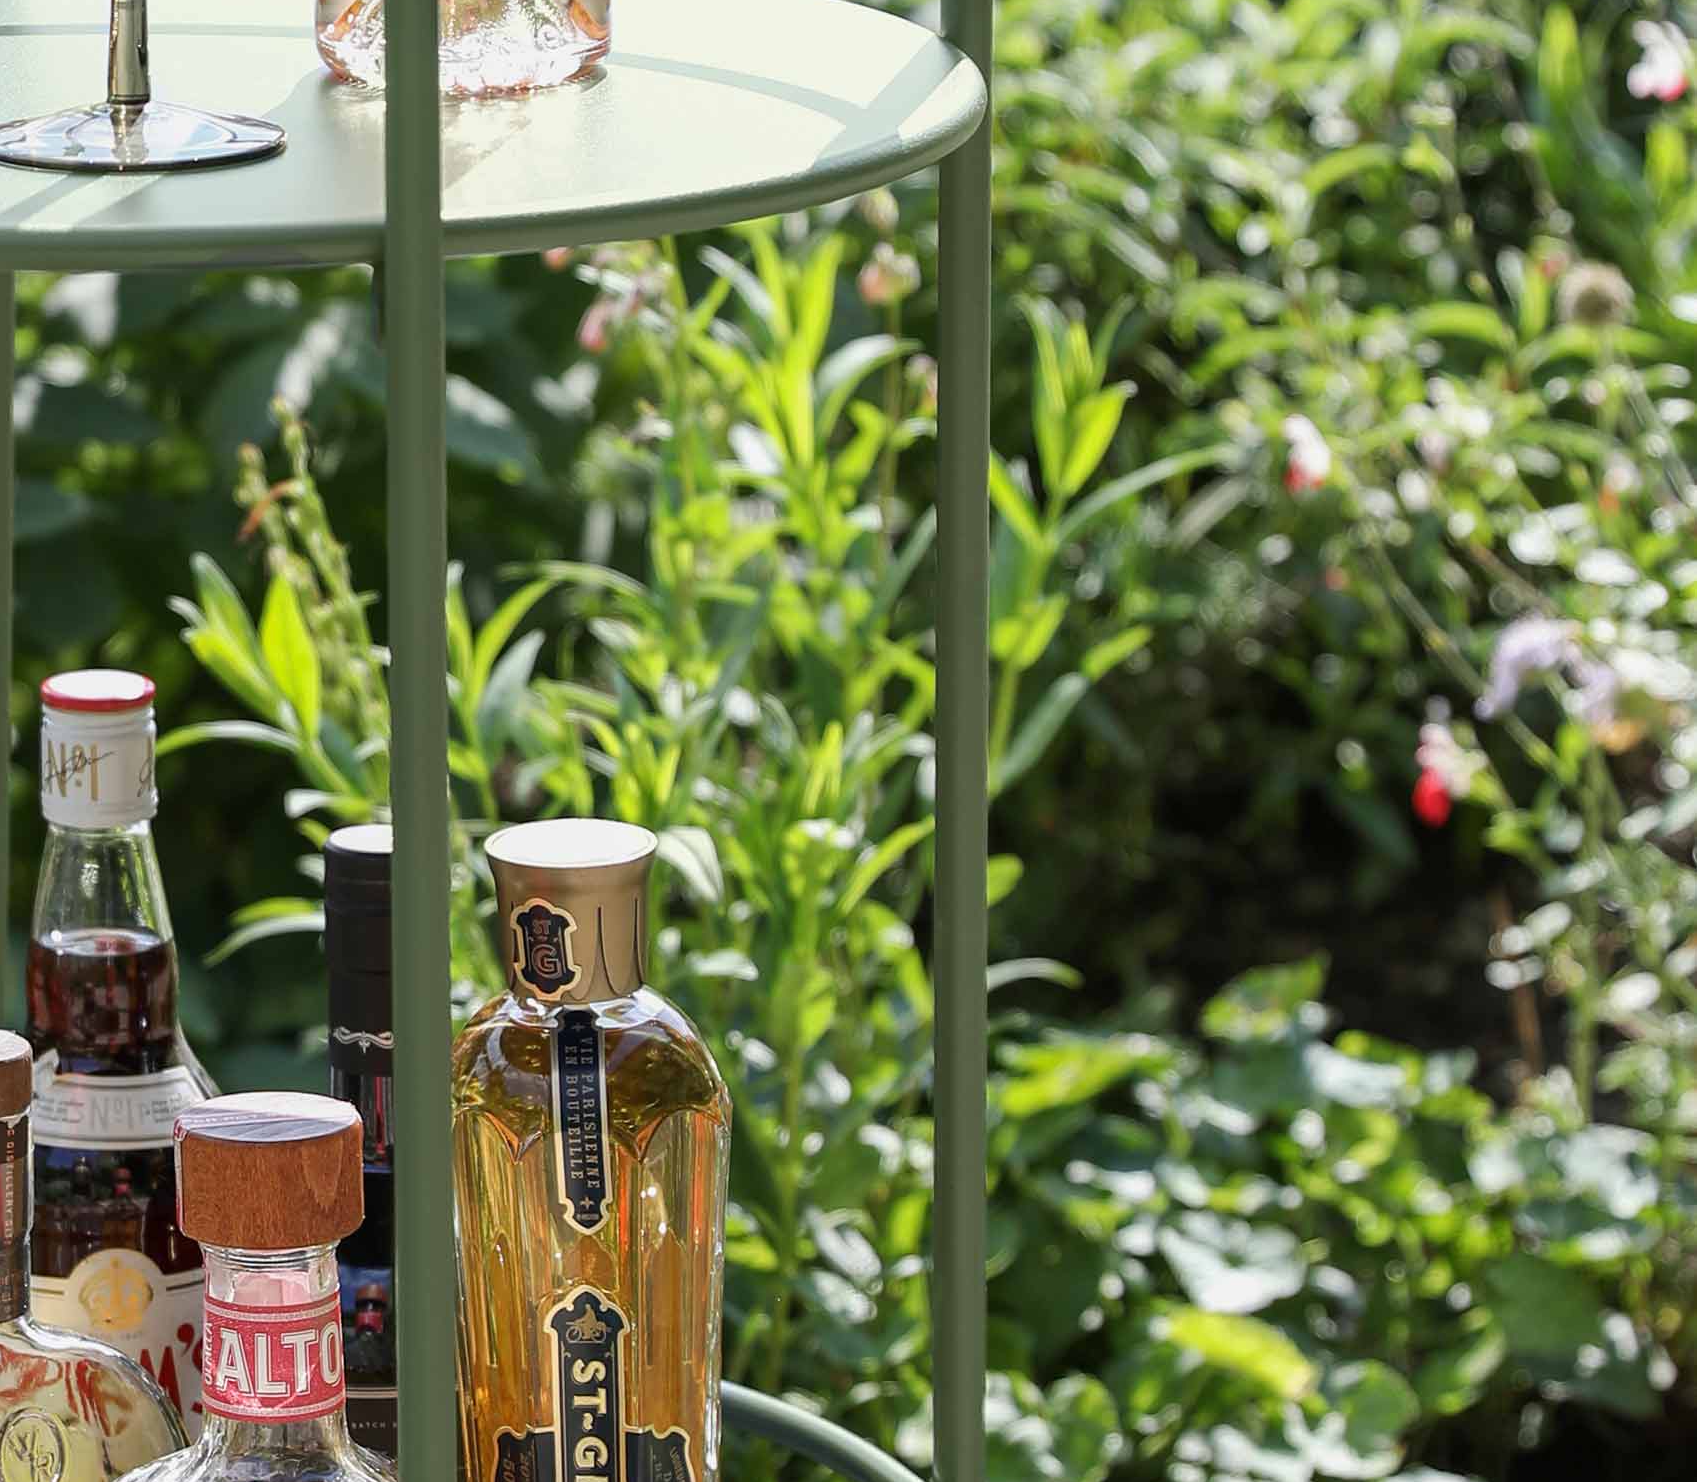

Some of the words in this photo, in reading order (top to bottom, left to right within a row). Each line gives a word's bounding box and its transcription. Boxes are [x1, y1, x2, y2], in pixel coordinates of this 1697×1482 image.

[565, 1046, 577, 1065] EN
[581, 1038, 593, 1065] VIE
[566, 1075, 584, 1180] BOUTEILLE
[581, 1074, 600, 1189] PARISIENNE
